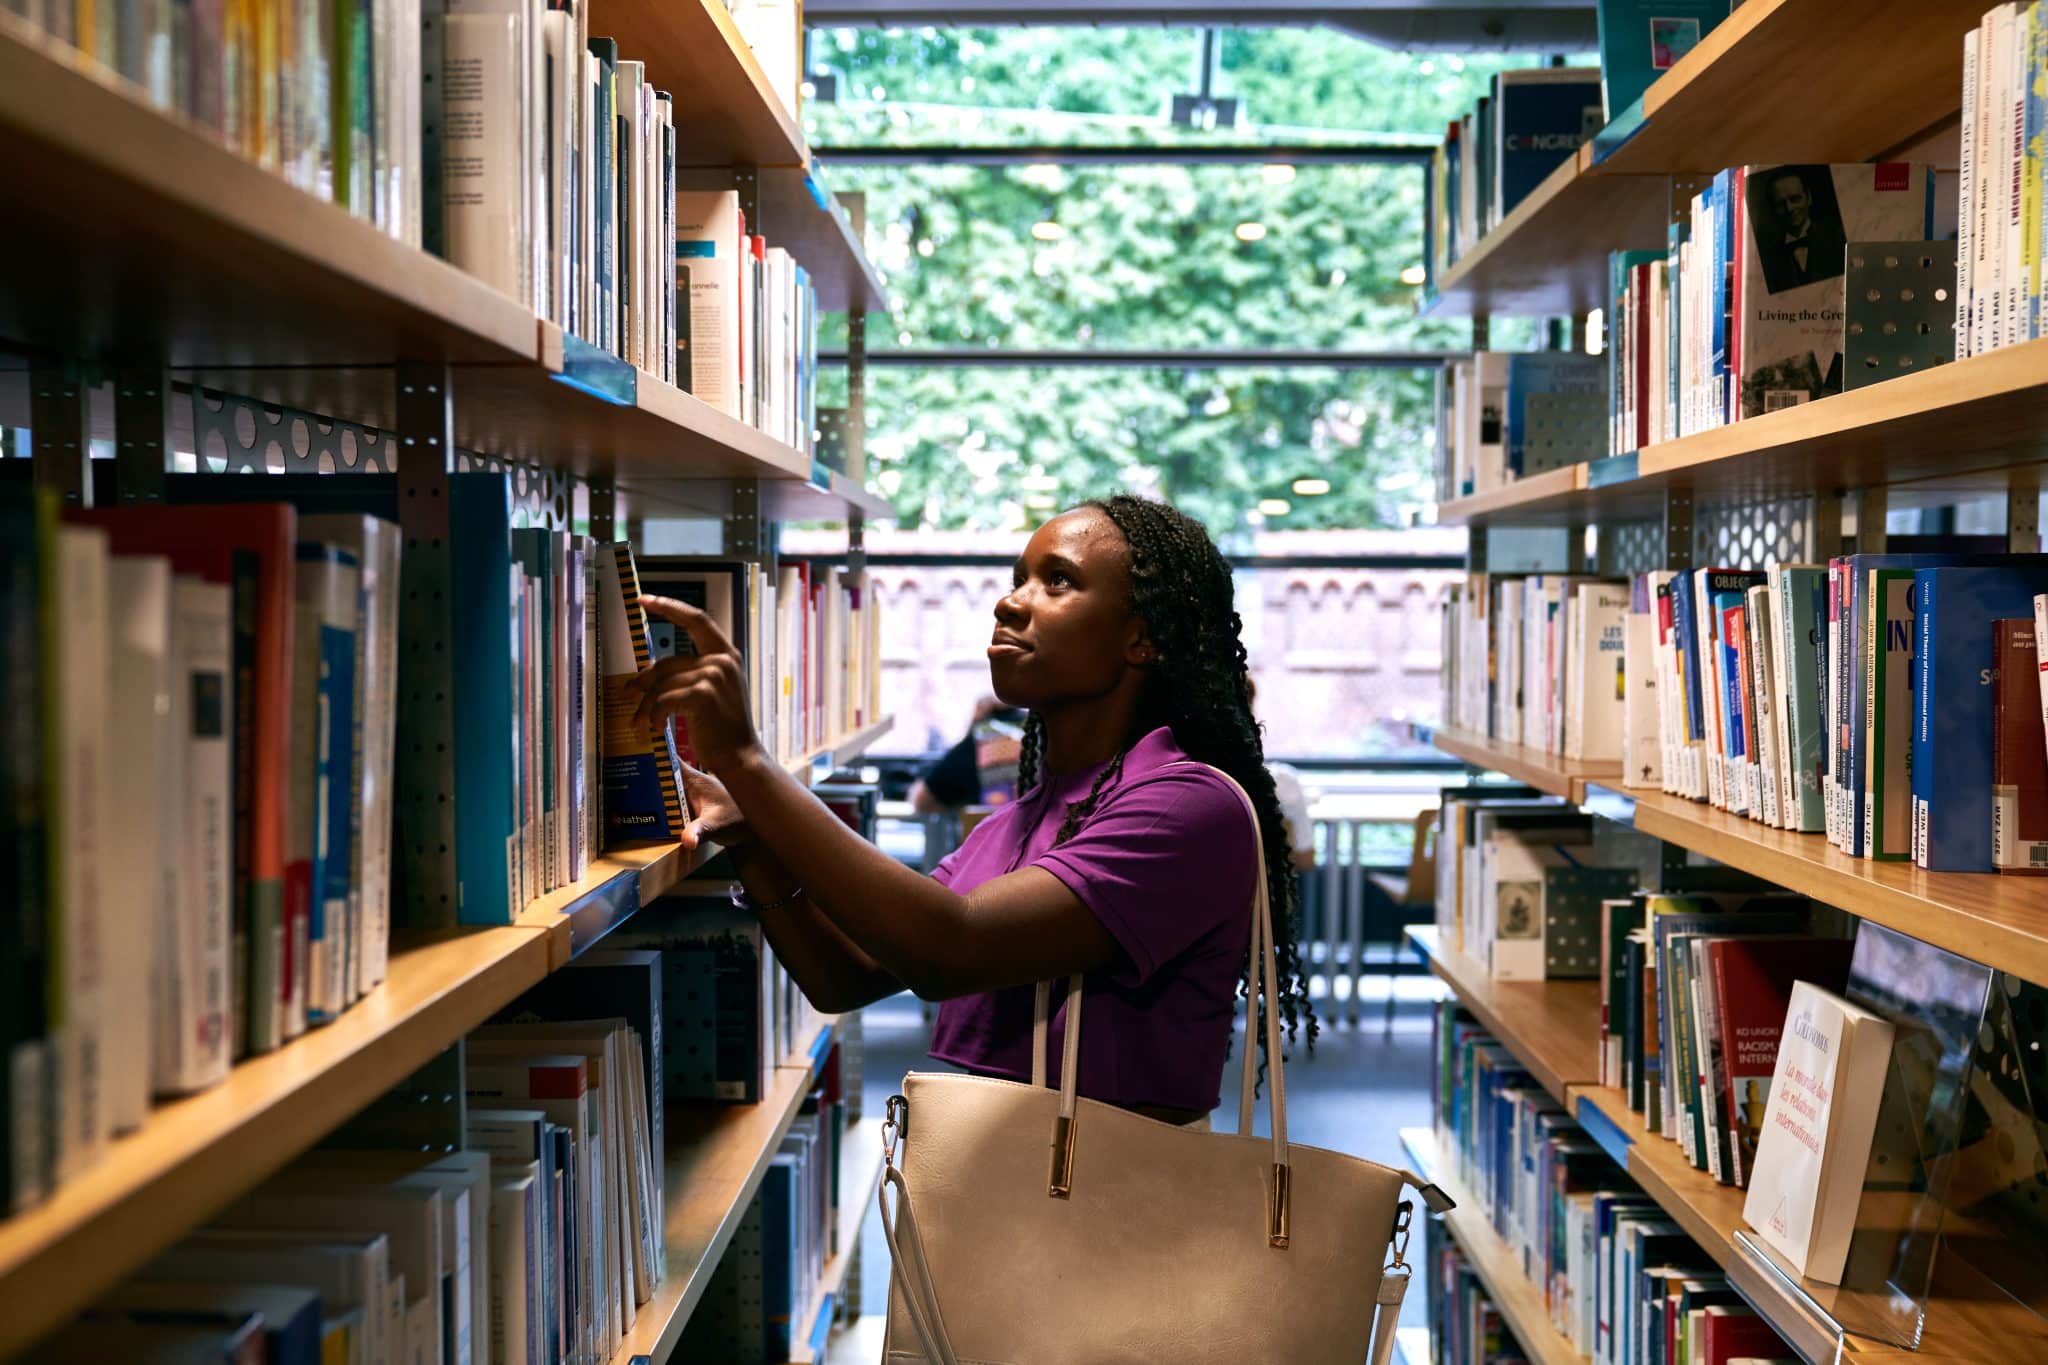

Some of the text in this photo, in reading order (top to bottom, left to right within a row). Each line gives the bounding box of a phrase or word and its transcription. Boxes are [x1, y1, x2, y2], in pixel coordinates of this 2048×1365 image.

[1758, 309, 1796, 323] Living
[1798, 308, 1818, 321] the
[617, 813, 656, 825] Nathan
[1738, 1041, 1777, 1051] RACISM,
